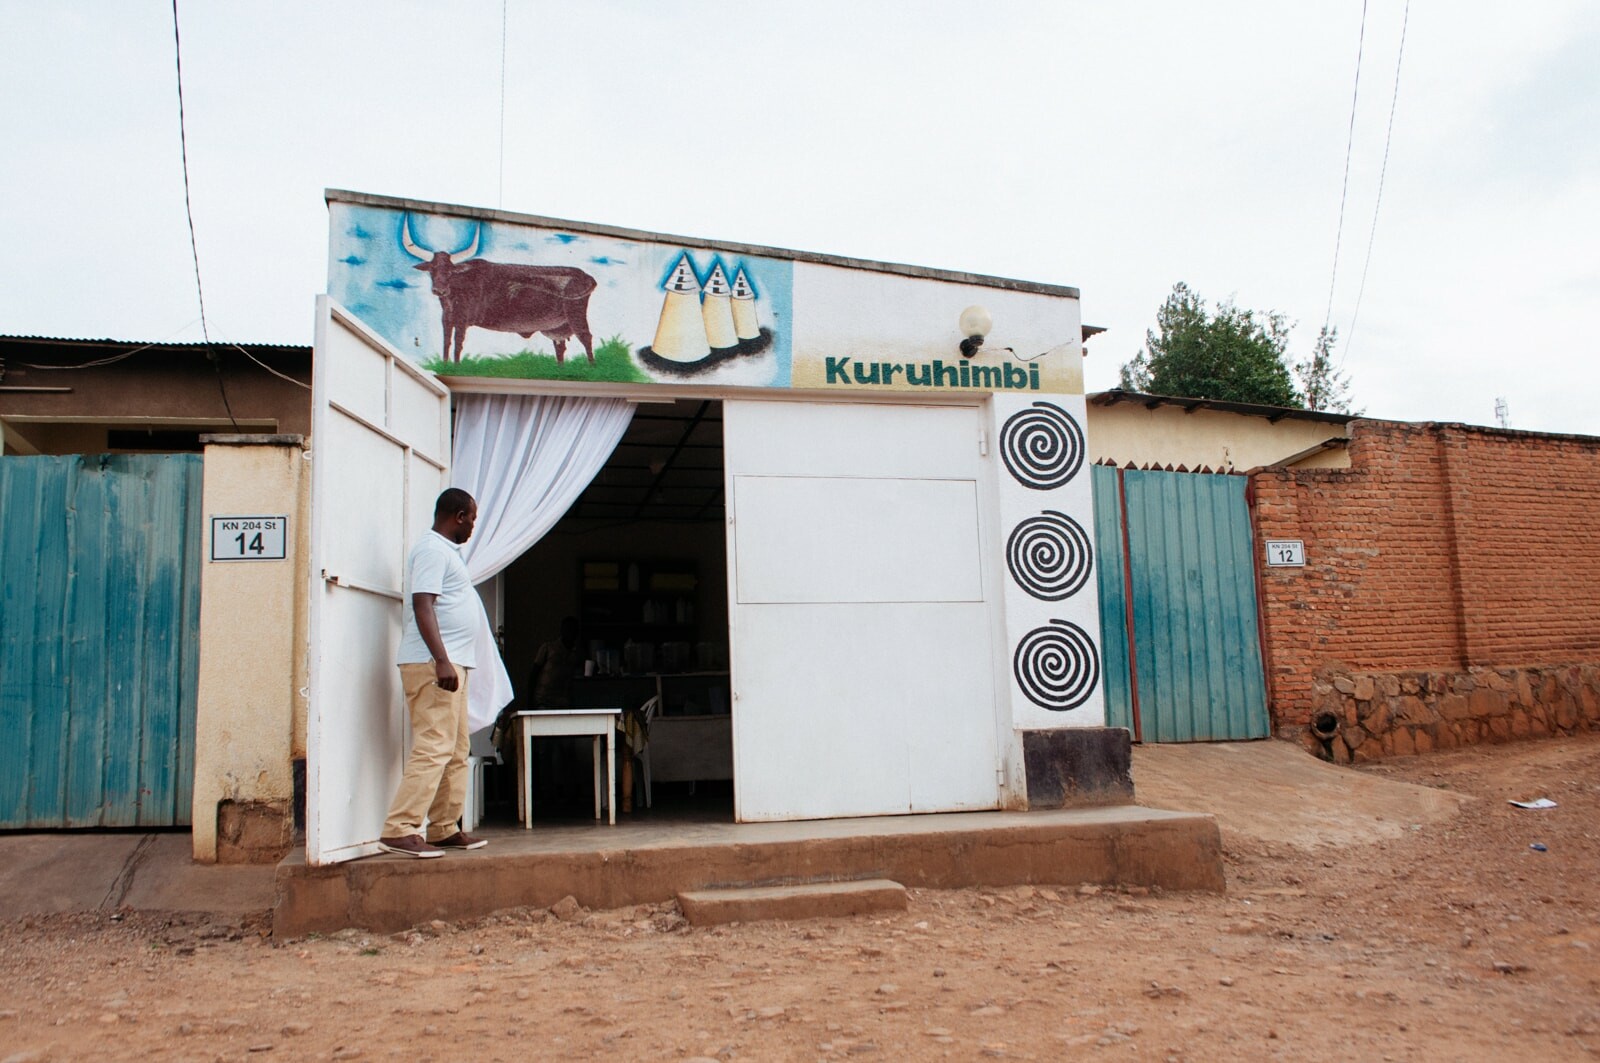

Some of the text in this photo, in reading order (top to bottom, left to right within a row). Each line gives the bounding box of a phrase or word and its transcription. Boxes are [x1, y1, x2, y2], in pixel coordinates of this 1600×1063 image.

[825, 357, 1040, 390] Kuruhimbi
[222, 521, 277, 530] KN 204 St
[235, 532, 265, 555] 14
[1278, 549, 1294, 562] 12
